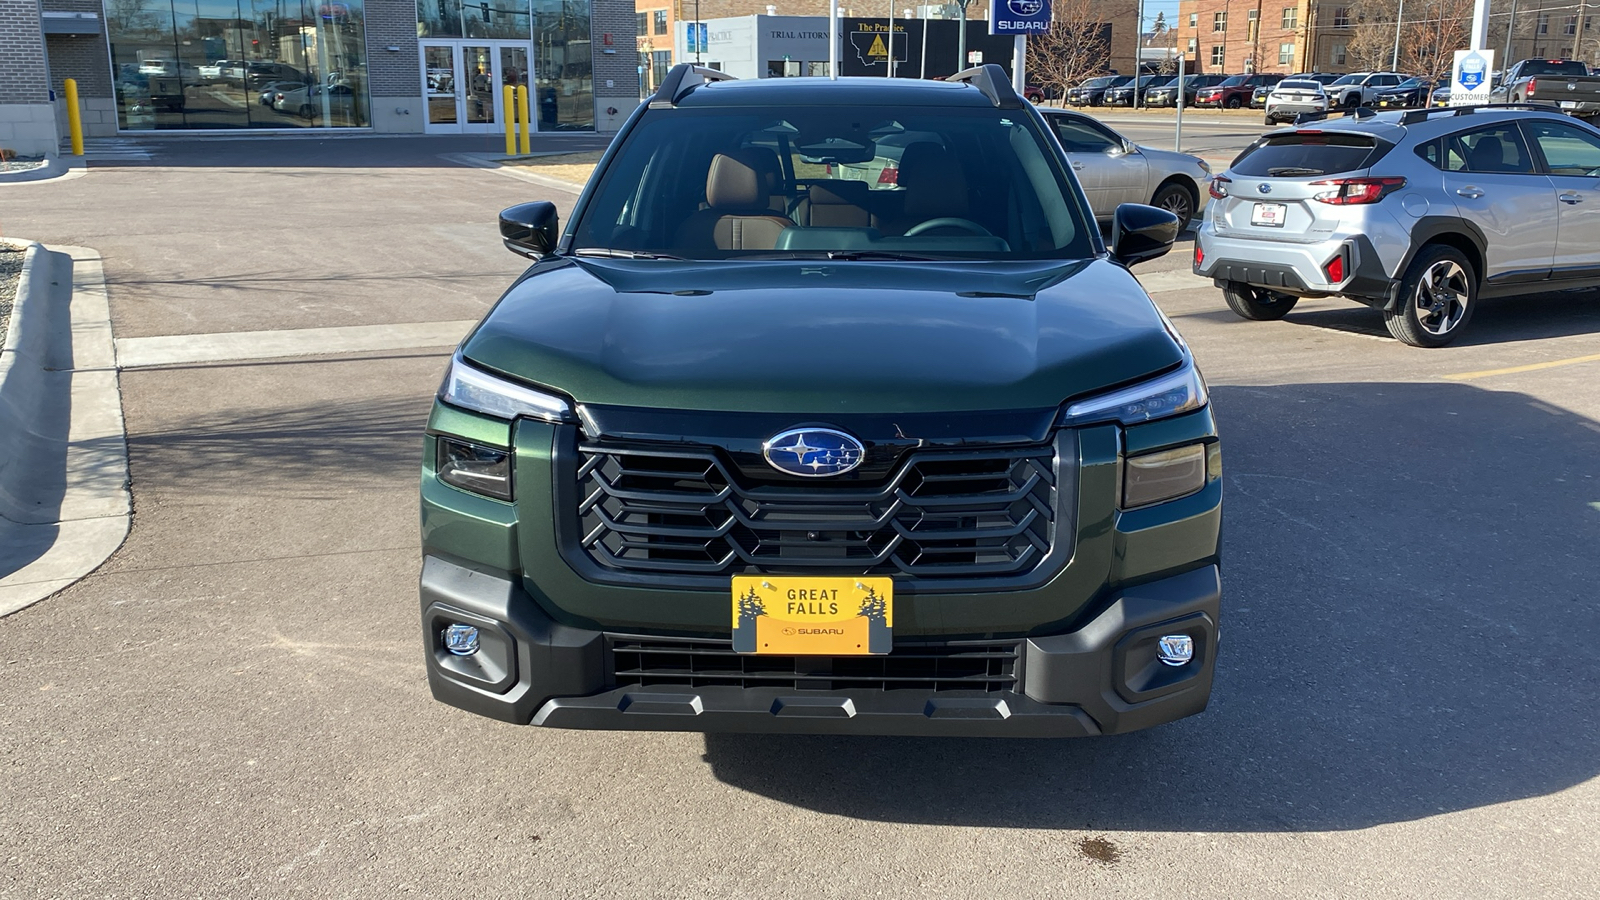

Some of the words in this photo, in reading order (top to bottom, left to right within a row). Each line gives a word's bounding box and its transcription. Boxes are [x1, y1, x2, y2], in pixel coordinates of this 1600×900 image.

[858, 23, 873, 32] The
[874, 23, 904, 32] Praice
[998, 20, 1048, 30] SUBARU
[708, 31, 733, 41] PRACTICE
[770, 31, 795, 39] TRIAL
[1450, 93, 1489, 101] CUSTOMER
[787, 589, 838, 601] GREAT
[787, 602, 838, 615] FALLS
